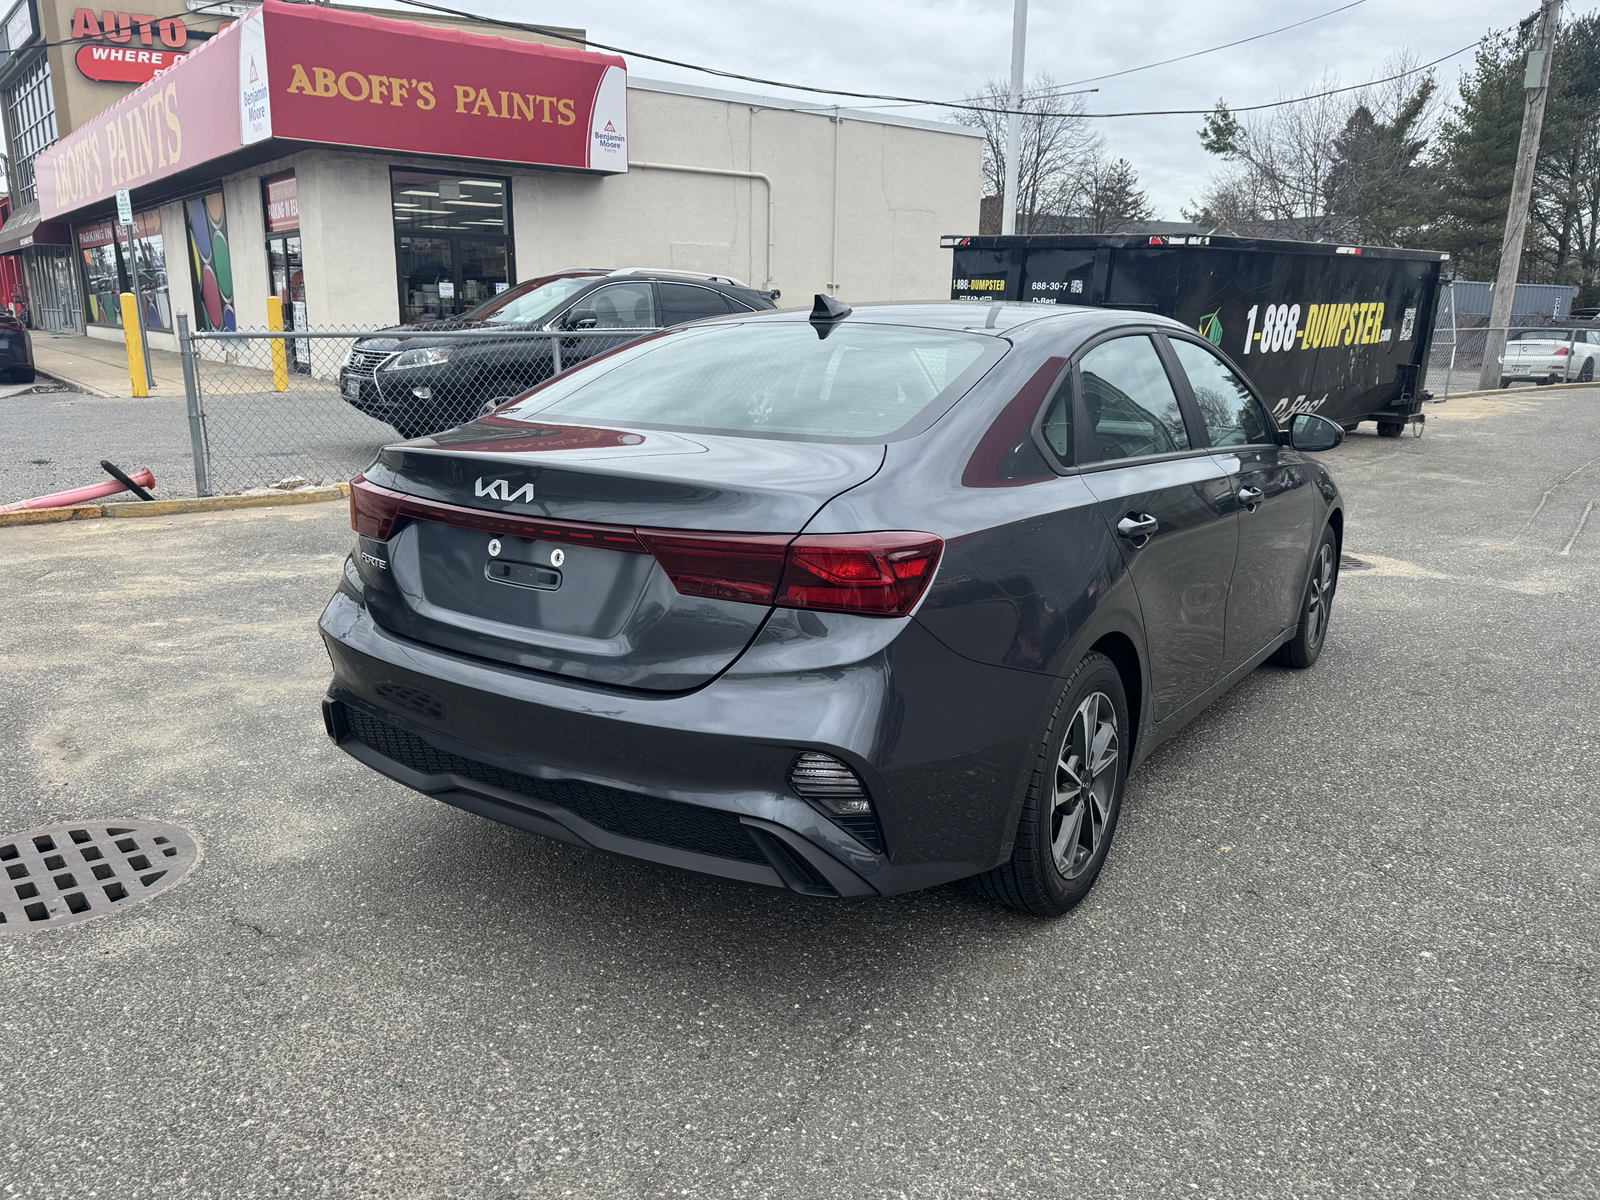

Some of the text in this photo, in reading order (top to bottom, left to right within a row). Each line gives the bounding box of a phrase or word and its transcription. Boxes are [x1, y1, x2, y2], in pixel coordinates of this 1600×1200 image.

[71, 7, 187, 48] AUTO
[92, 48, 163, 65] WHERE
[243, 83, 267, 107] Benjamin
[286, 63, 576, 126] ABOFF'S PAINTS
[248, 105, 265, 122] Moore
[53, 80, 182, 209] ABOFF'S PAINTS
[594, 131, 625, 142] Benjamin
[599, 139, 621, 149] Moore
[79, 221, 140, 243] PARKING IN RER
[953, 279, 1005, 291] 1-888-DUMPSTER
[1031, 281, 1069, 291] 888-30-7
[361, 551, 387, 570] FORTE
